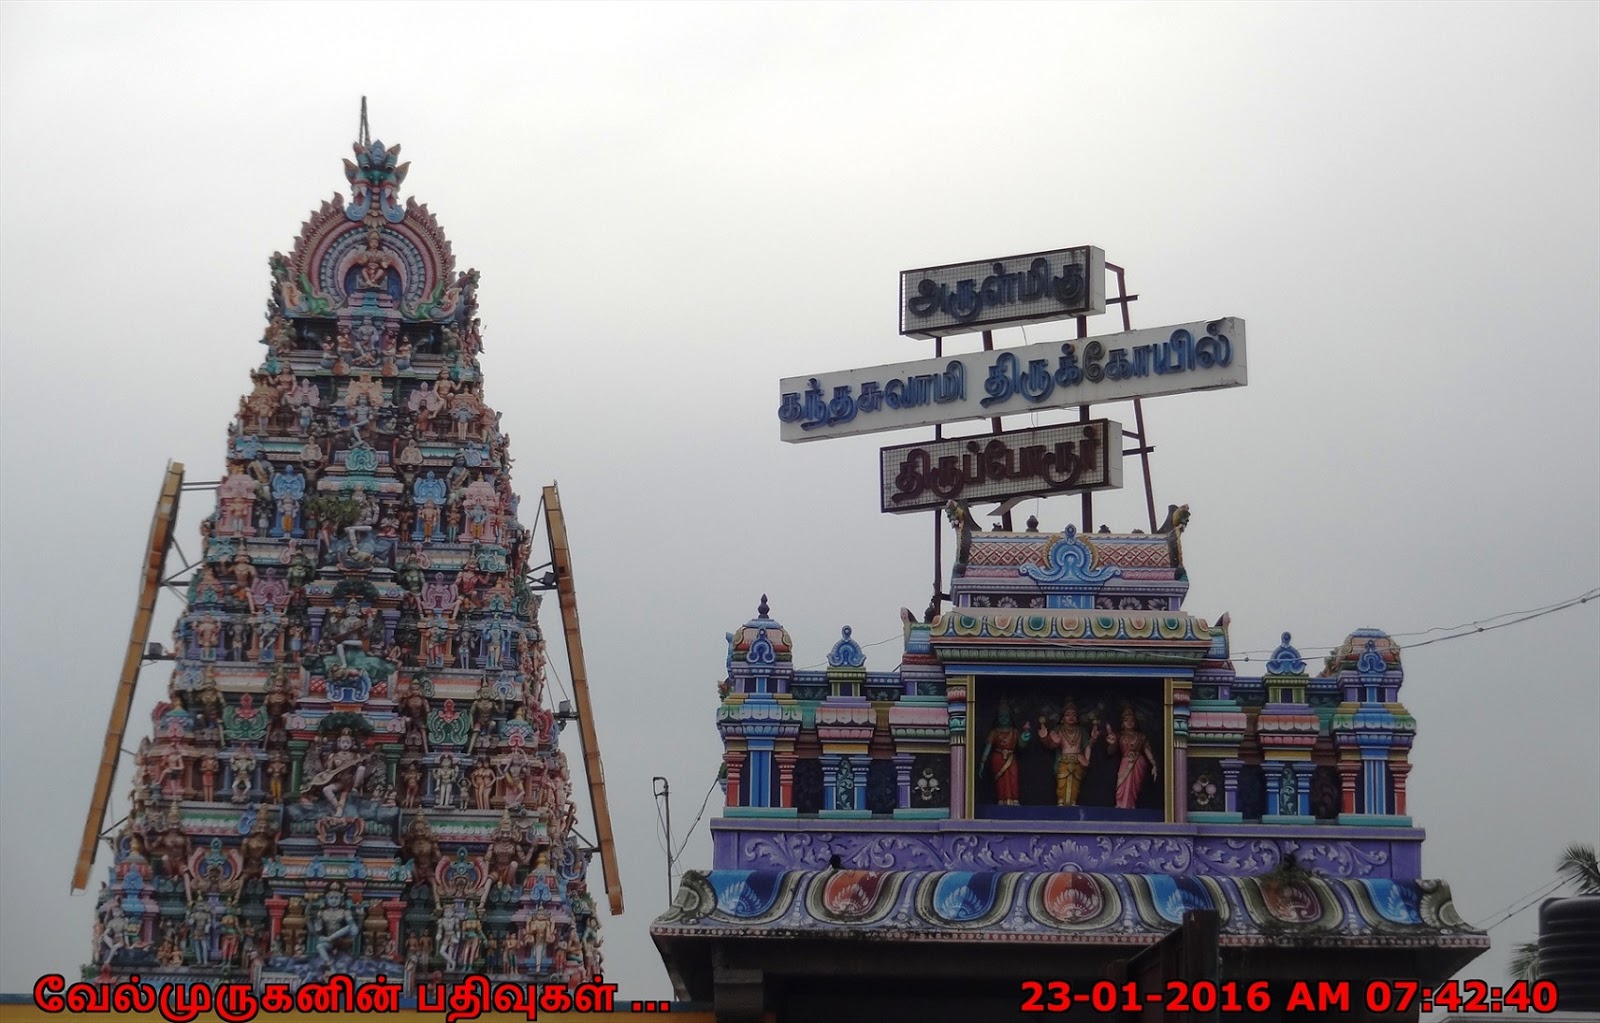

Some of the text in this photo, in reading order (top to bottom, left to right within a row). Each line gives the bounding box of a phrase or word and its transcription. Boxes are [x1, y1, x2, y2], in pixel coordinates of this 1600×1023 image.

[908, 257, 1085, 323] அருள்மிகு
[778, 322, 1233, 431] கந்தசுவாமி திருக்கோயில்
[891, 425, 1101, 503] திருப்போரூர்
